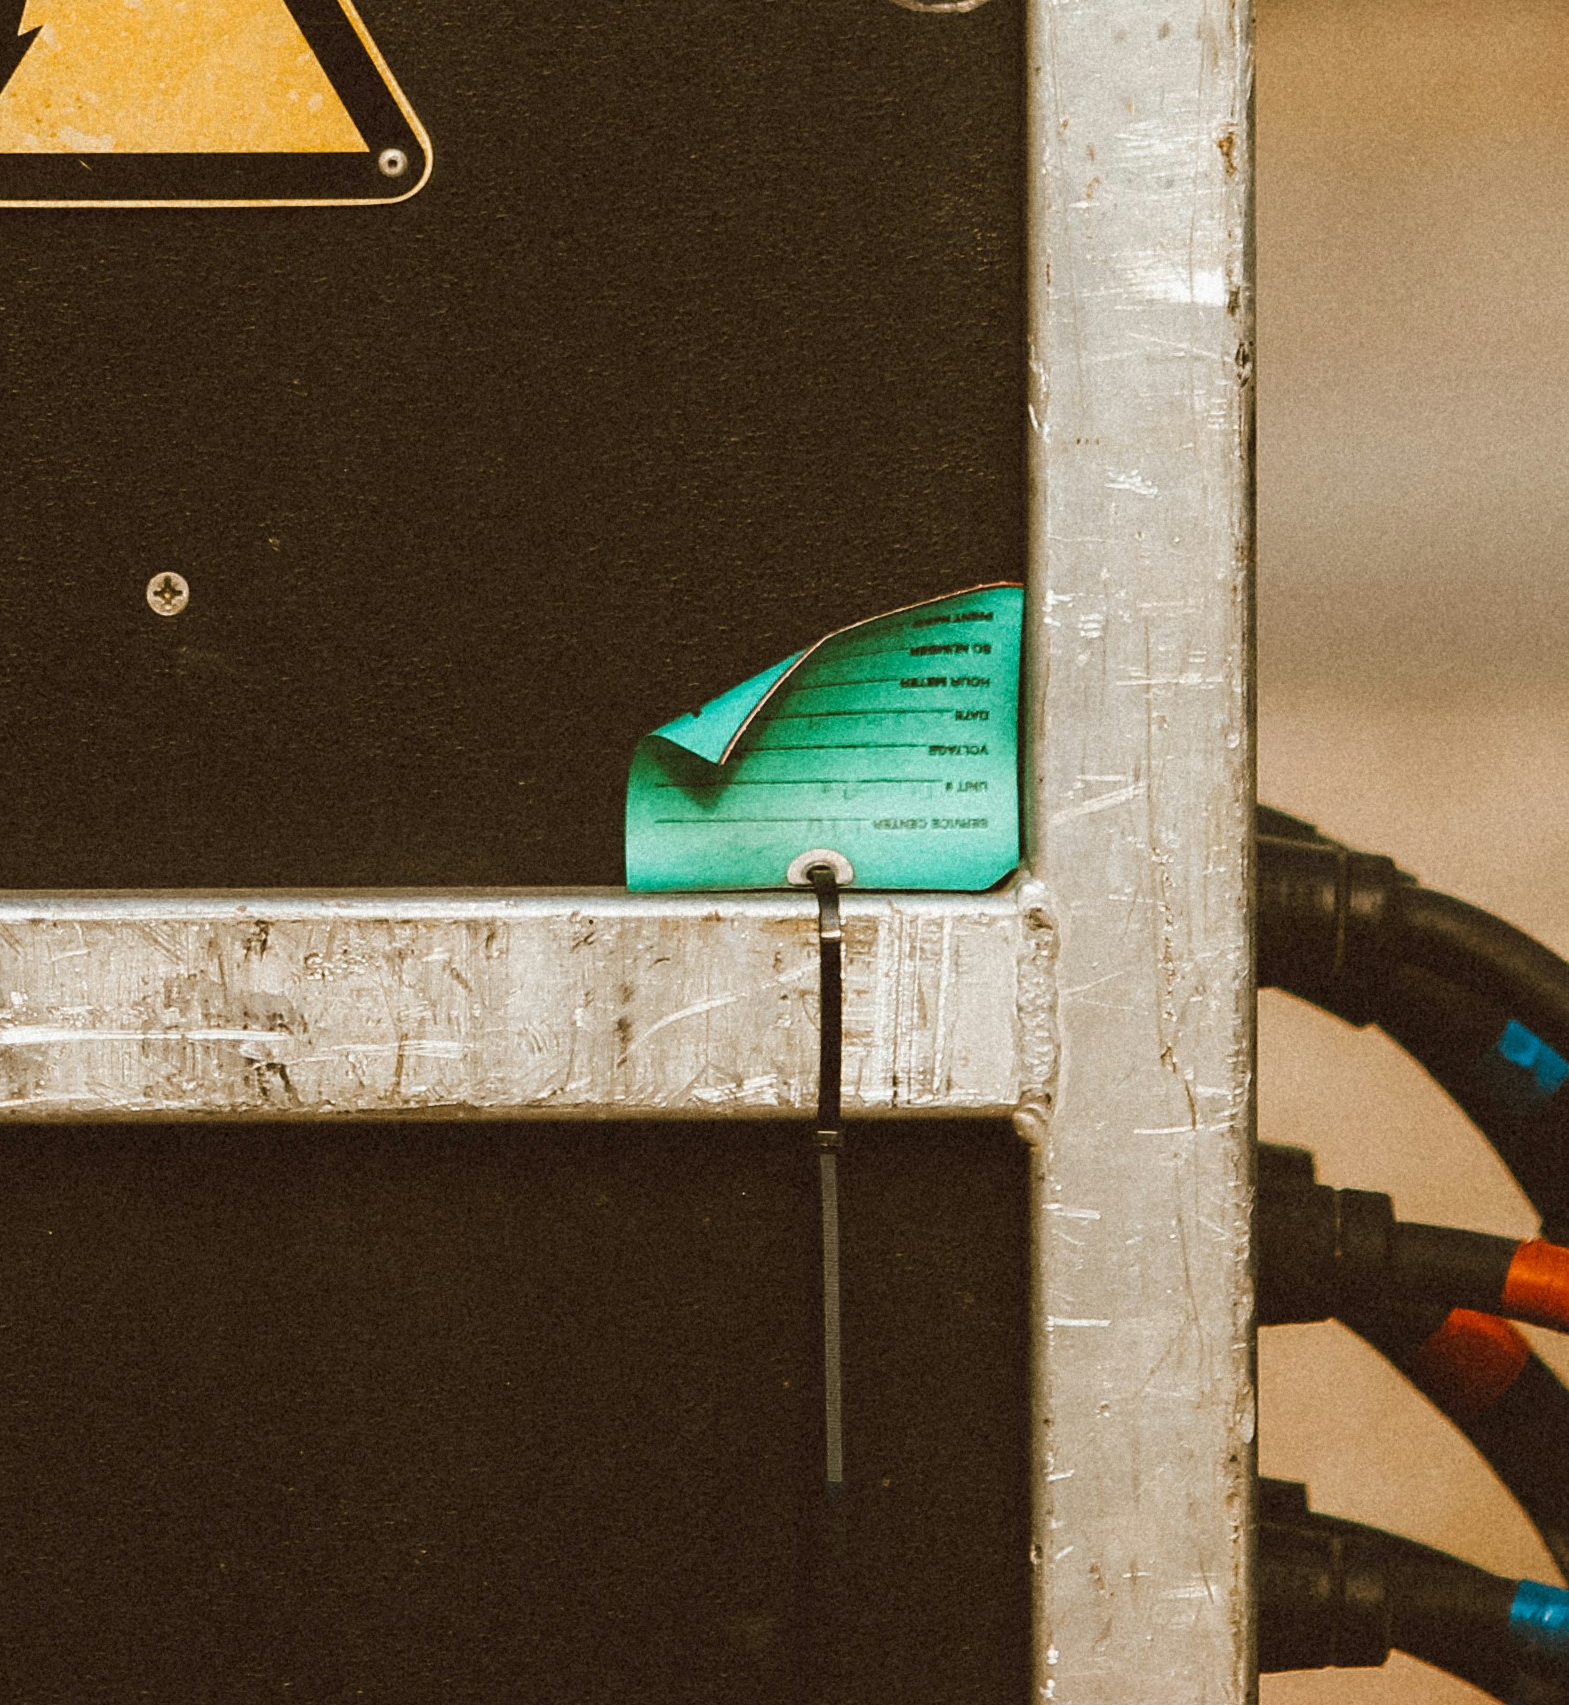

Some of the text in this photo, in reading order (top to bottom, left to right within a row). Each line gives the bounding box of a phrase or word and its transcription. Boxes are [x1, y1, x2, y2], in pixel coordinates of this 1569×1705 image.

[900, 677, 991, 688] HOUR METER
[955, 711, 989, 721] DATE
[929, 744, 989, 756] VOLTAGE
[957, 780, 988, 792] UNIT
[872, 818, 928, 830] CENTER
[931, 818, 988, 829] SERVICE
